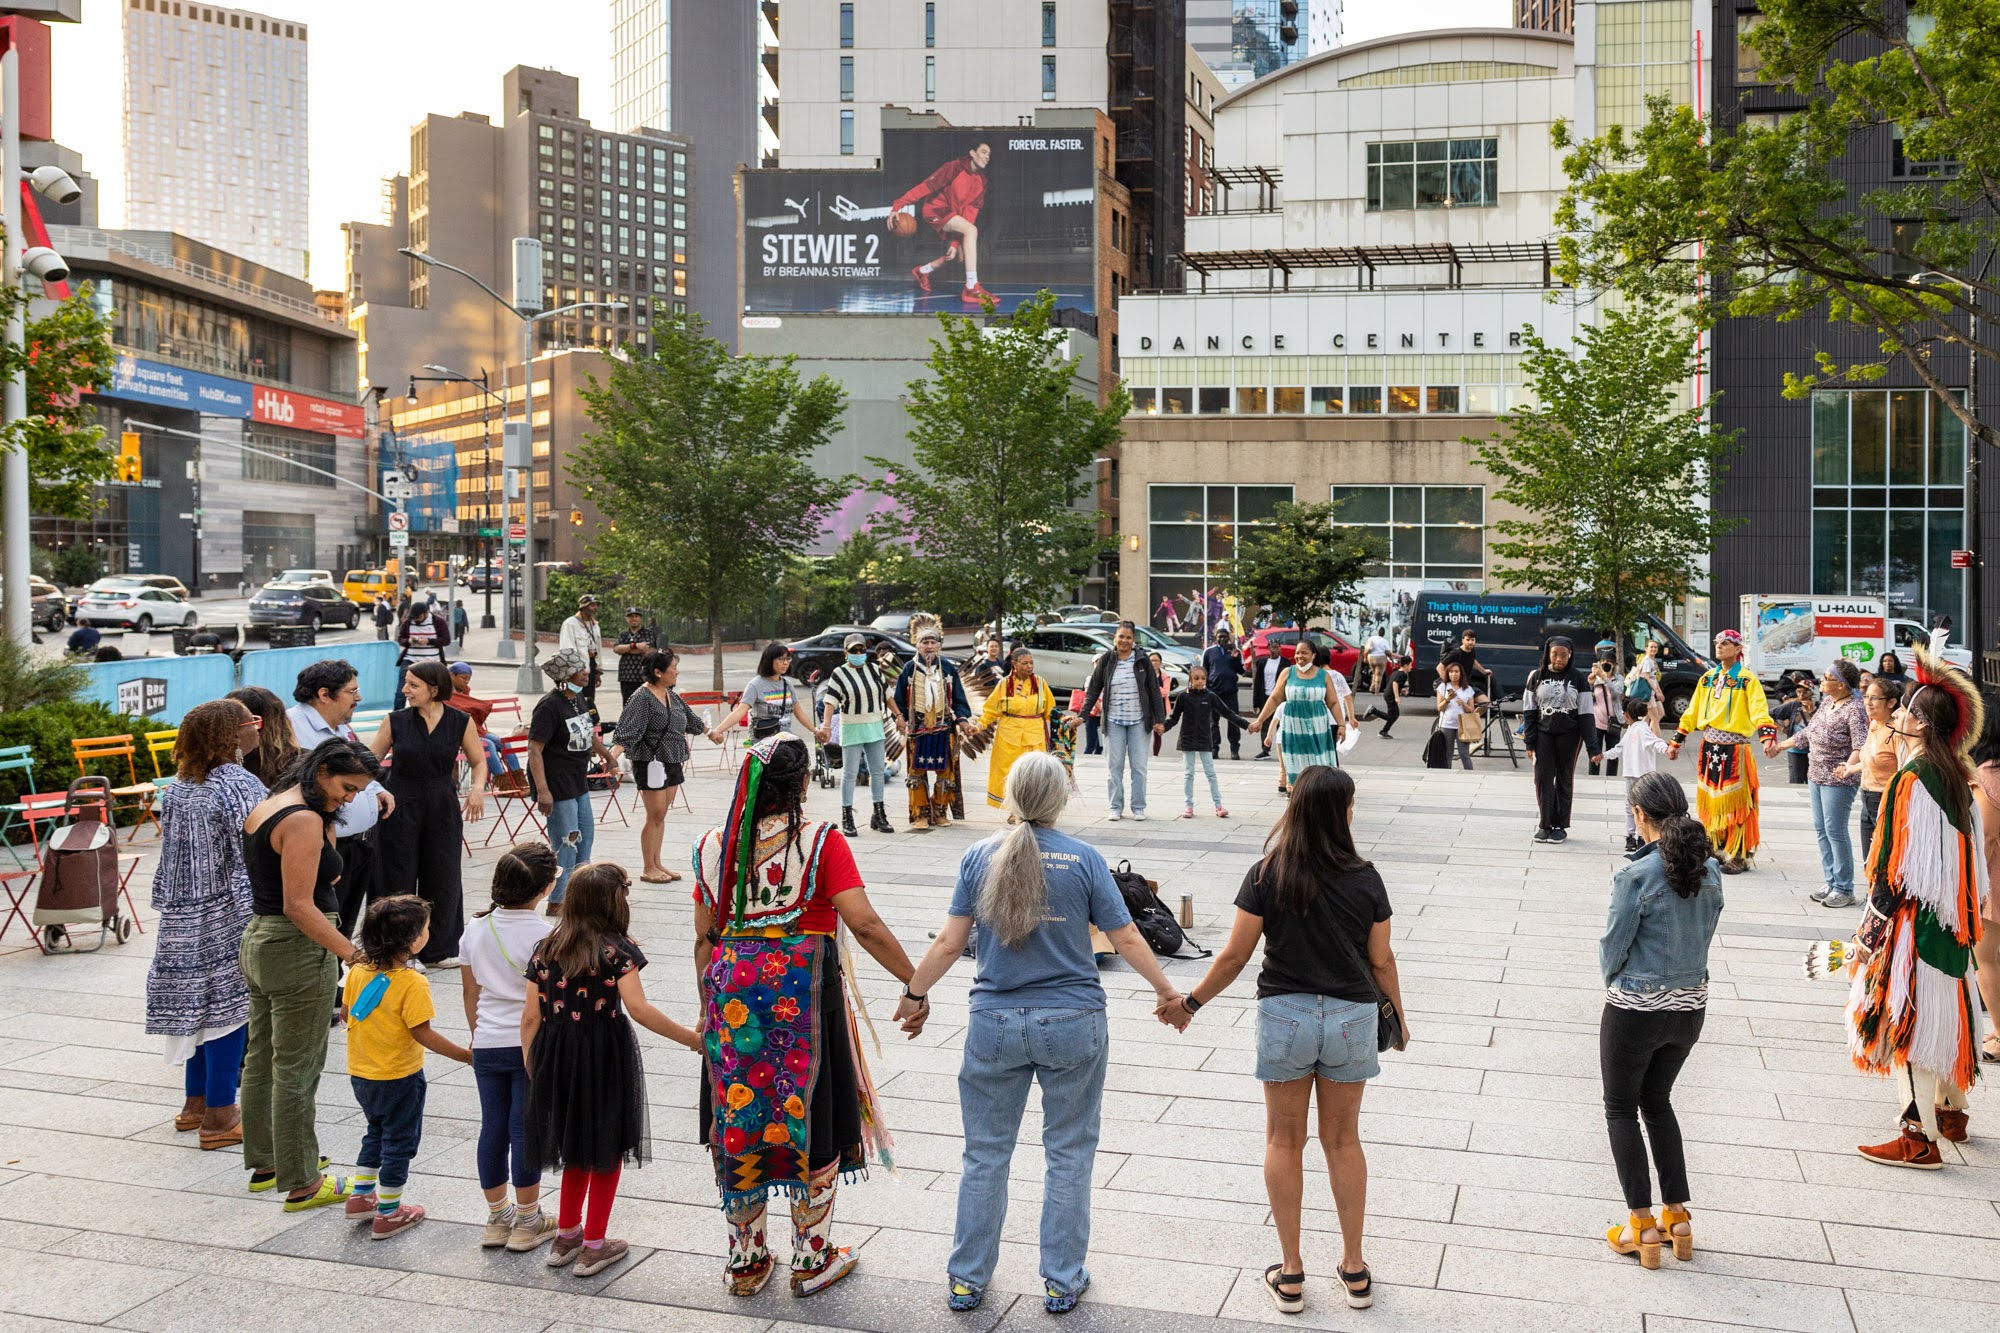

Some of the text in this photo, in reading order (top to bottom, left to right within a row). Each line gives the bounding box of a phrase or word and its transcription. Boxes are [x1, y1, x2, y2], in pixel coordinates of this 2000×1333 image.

[1009, 139, 1084, 150] FOREVER. FASTER.
[762, 234, 879, 264] STEWIE 2
[763, 267, 881, 277] BY BREANNA STEWART
[1140, 332, 1521, 350] DANCE CENTER
[137, 368, 166, 384] square
[166, 371, 184, 387] feet
[116, 379, 148, 393] private
[149, 384, 190, 402] amenities
[199, 386, 242, 405] HubBK.com
[264, 391, 294, 423] Hub
[142, 478, 162, 489] CARE
[1427, 601, 1543, 615] That thing you wanted?
[1427, 613, 1517, 625] It's right. In. Here.
[1427, 628, 1452, 638] prime
[146, 684, 165, 696] BRK
[121, 696, 165, 711] TWN LYN
[1040, 851, 1080, 863] OR WILDLIFE
[1041, 914, 1067, 922] Einstein
